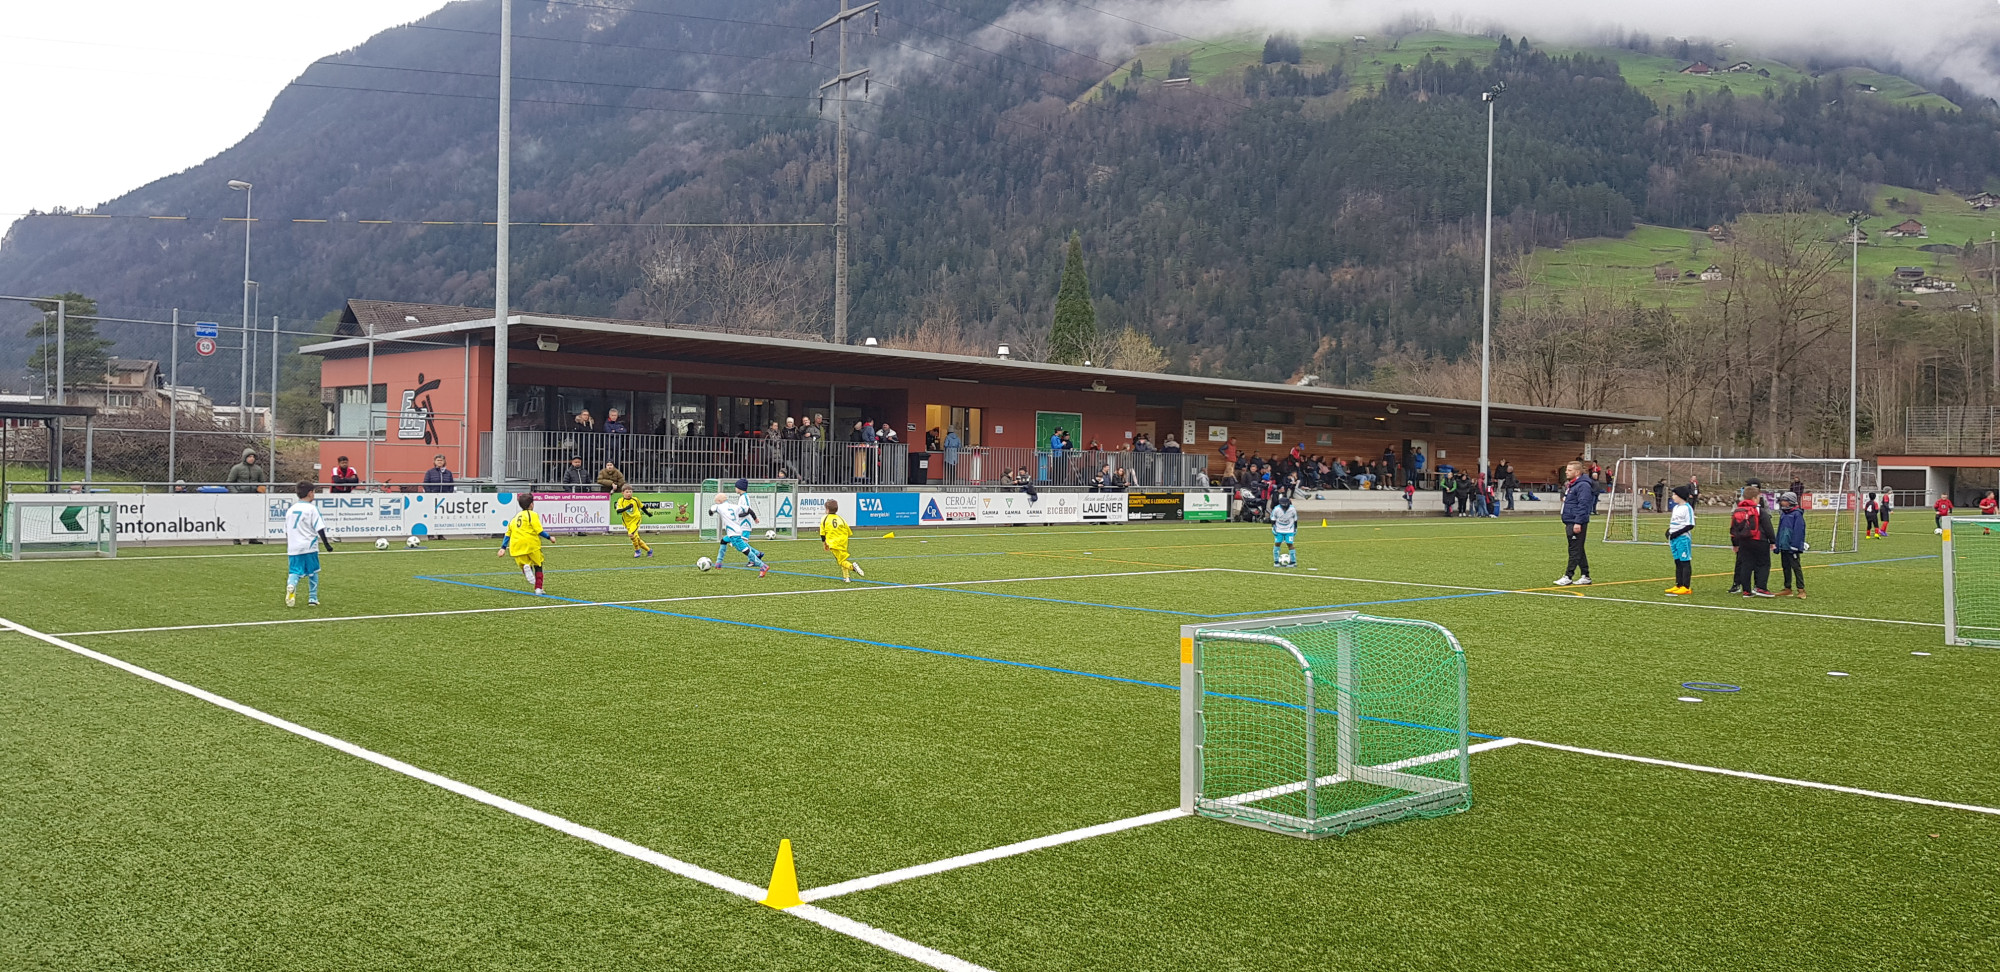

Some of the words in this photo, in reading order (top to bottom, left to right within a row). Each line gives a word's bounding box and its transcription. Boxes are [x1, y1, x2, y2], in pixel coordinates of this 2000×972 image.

[313, 498, 374, 508] TEINER
[434, 497, 488, 514] Kuster
[859, 499, 883, 511] EWA
[945, 496, 965, 506] CERO
[967, 496, 977, 505] AG
[1083, 503, 1123, 513] LAUENER
[292, 511, 302, 529] 7
[728, 508, 737, 521] 3
[516, 515, 523, 528] 5
[832, 518, 838, 528] 6
